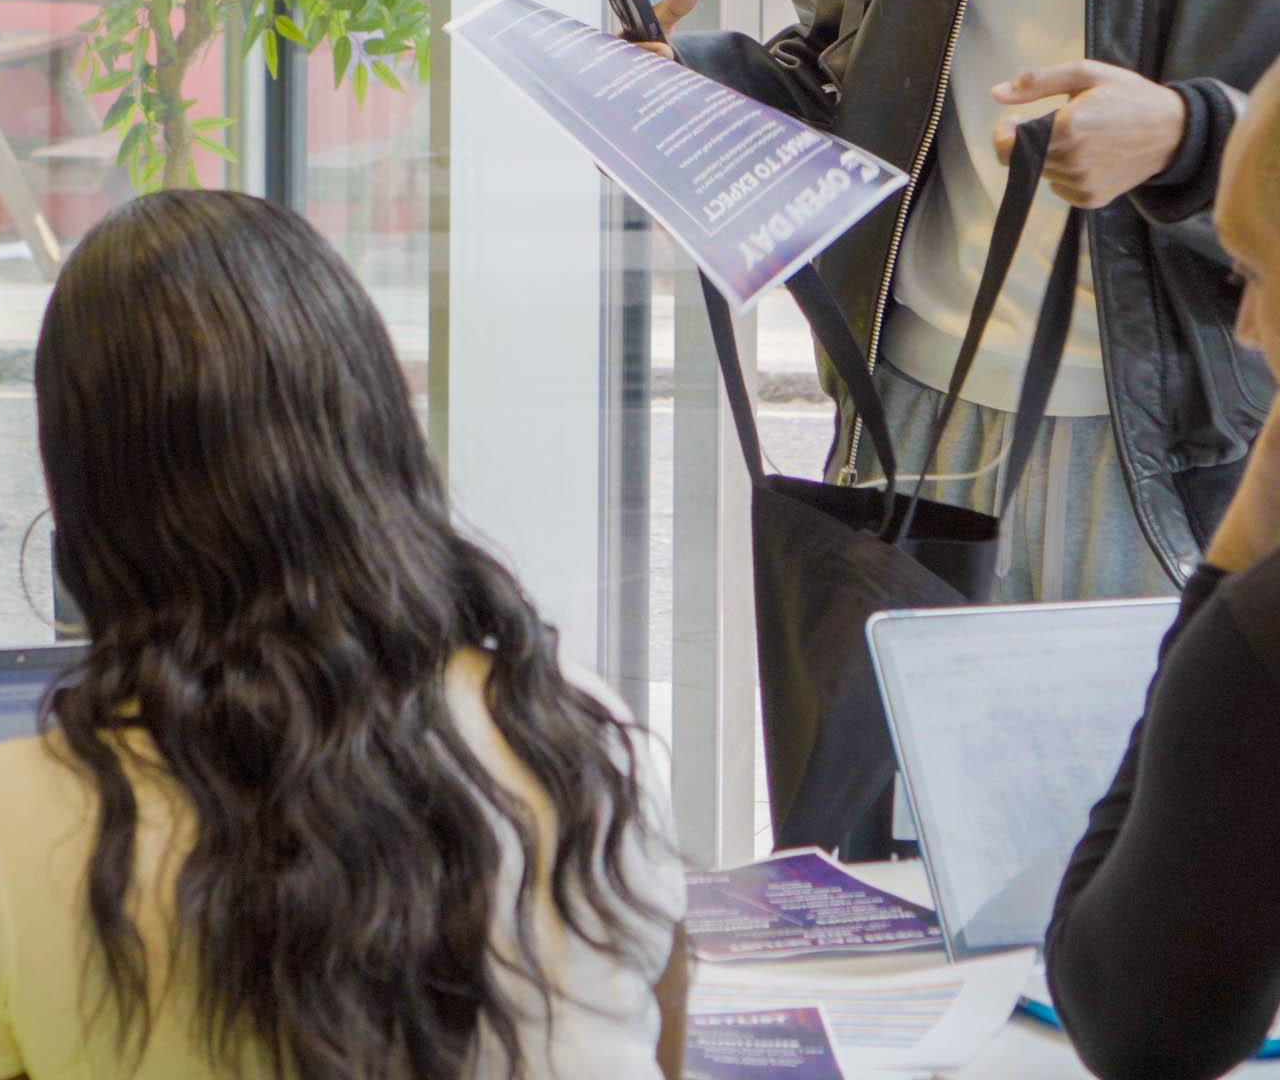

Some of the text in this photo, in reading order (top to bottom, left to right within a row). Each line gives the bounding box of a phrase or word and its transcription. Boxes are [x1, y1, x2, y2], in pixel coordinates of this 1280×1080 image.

[753, 156, 782, 180] TO
[703, 172, 761, 223] EXPECT
[738, 167, 852, 272] OPEN DAY
